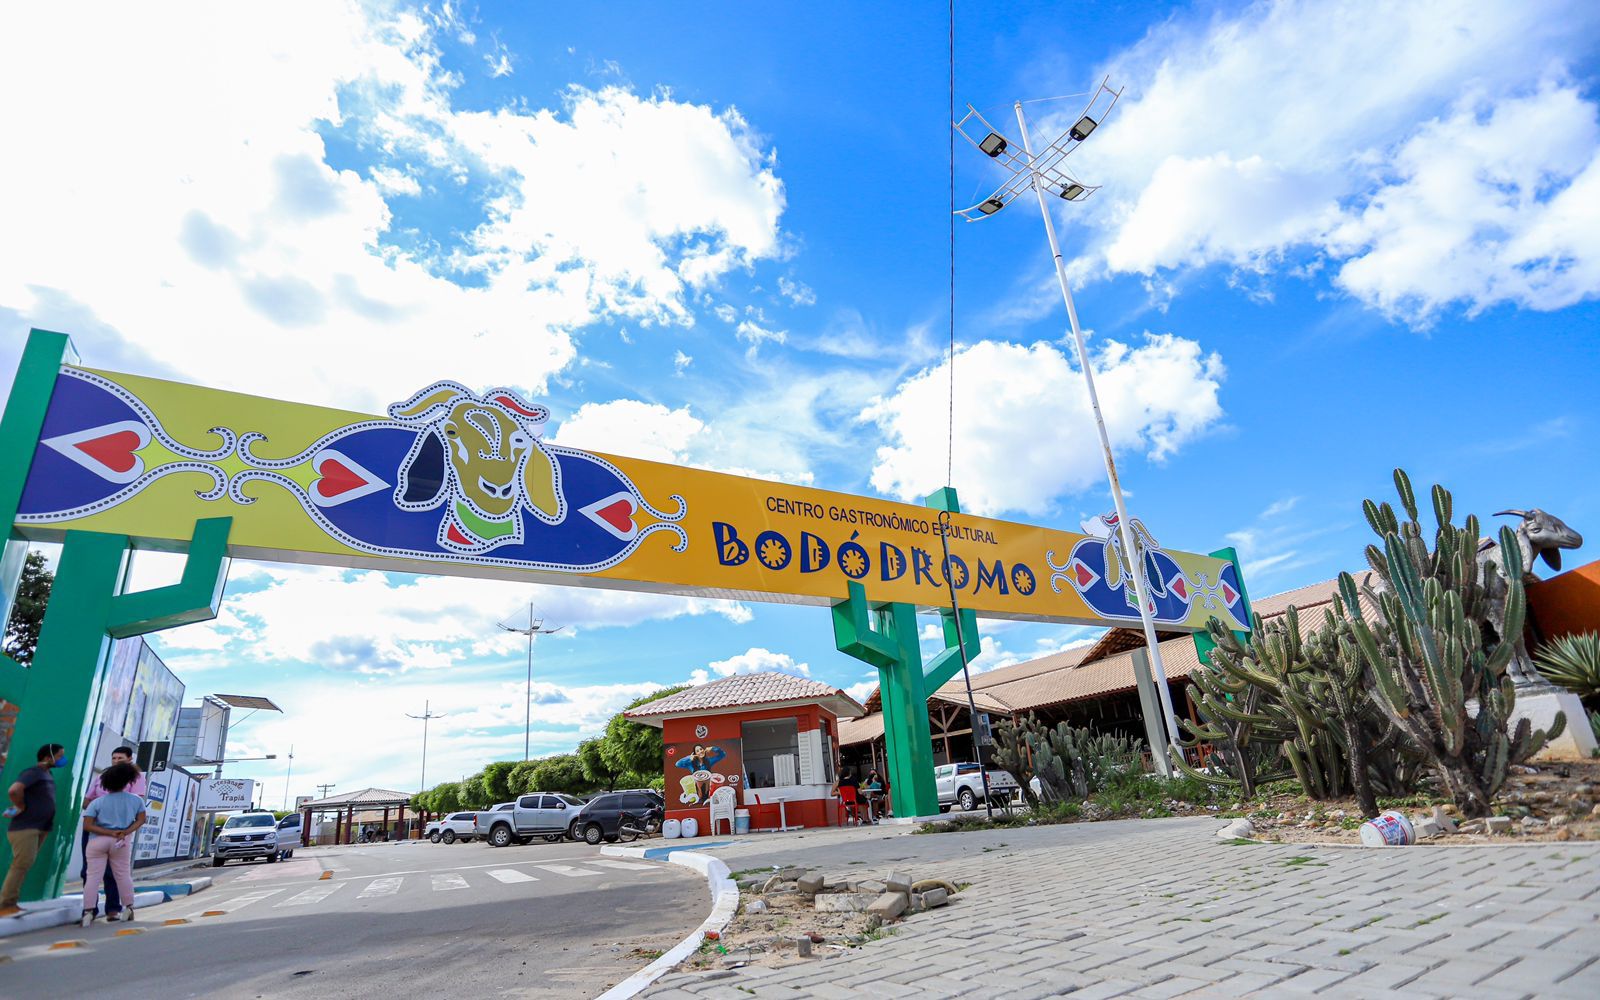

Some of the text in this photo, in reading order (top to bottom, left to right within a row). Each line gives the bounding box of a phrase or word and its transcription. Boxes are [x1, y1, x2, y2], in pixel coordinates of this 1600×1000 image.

[766, 496, 824, 519] CENTRO
[829, 504, 930, 534] GASTRONÔMICO
[932, 522, 942, 536] E
[711, 521, 1037, 597] BODÓDROMO
